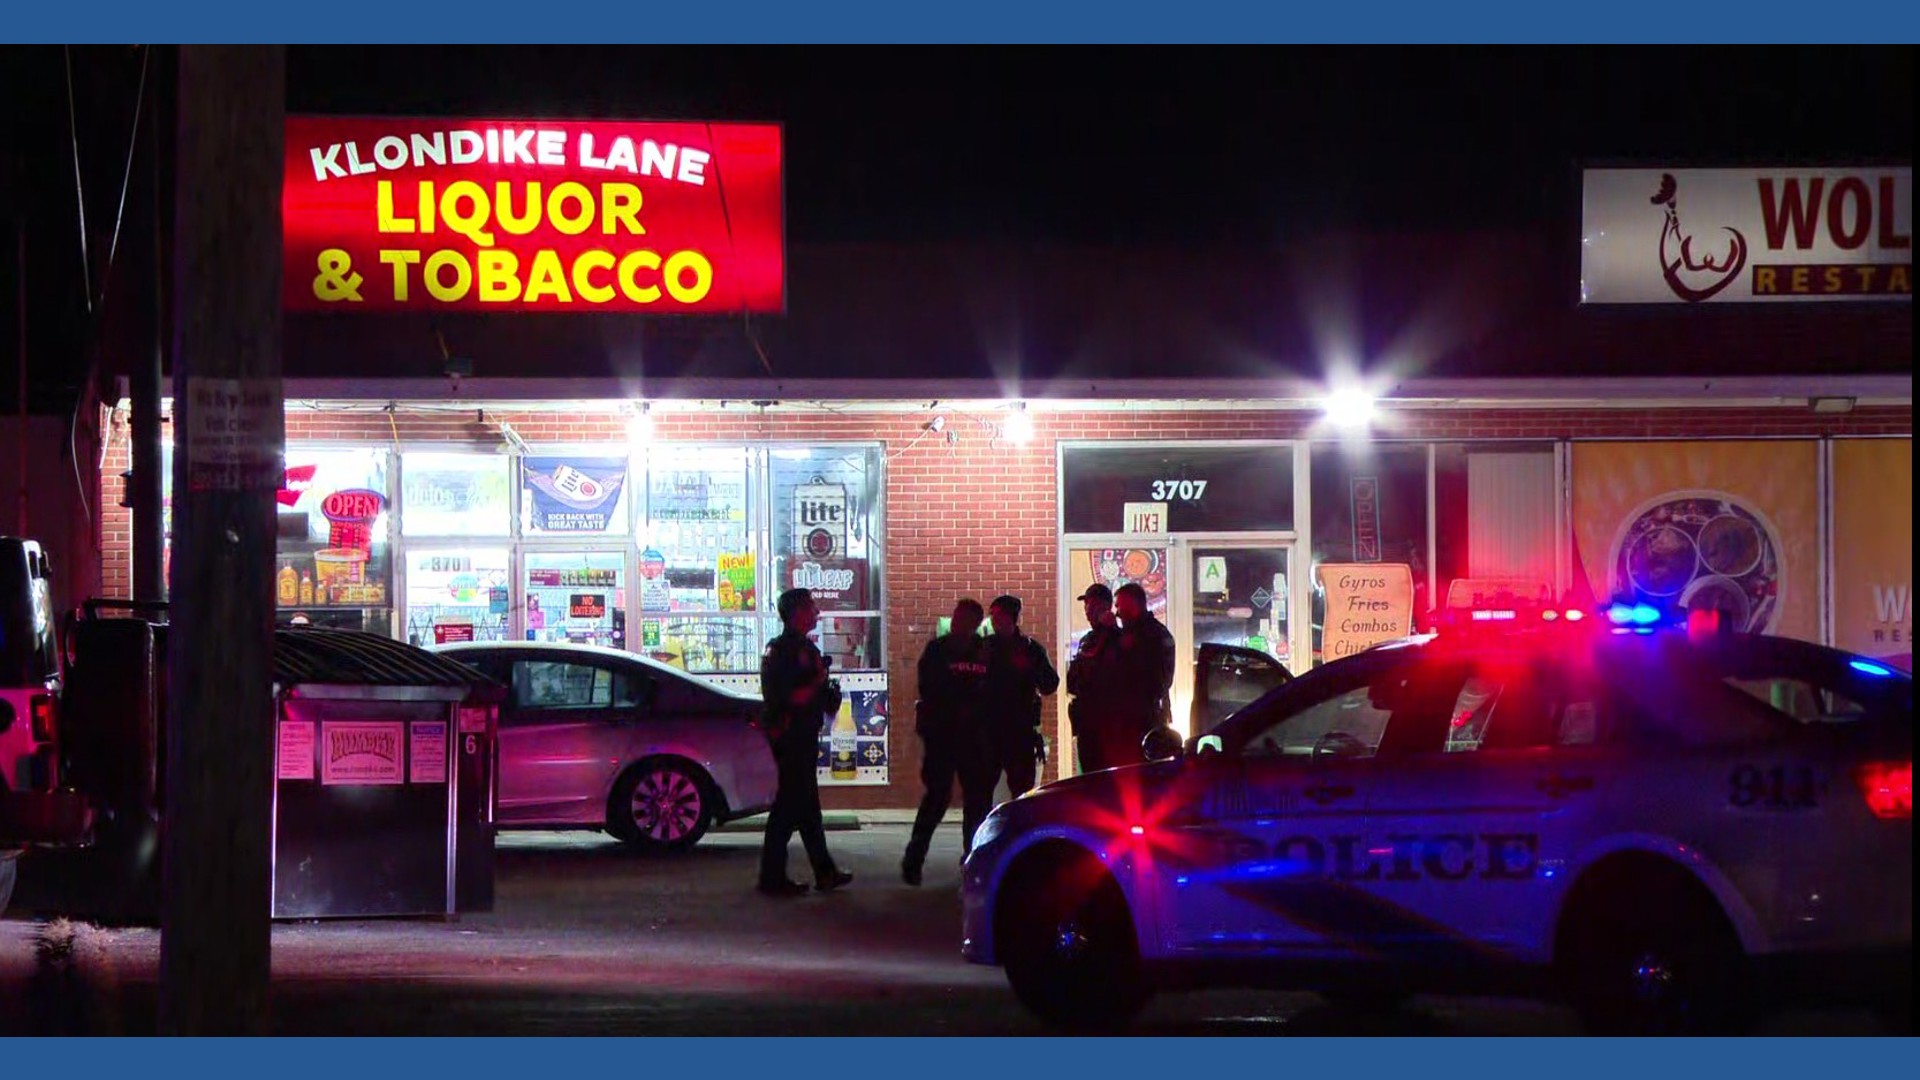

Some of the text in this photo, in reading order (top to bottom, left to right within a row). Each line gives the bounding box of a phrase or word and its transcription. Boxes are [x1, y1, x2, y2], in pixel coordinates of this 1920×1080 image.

[309, 128, 711, 186] KLONDIKE LANE
[377, 180, 646, 247] LIQUOR
[1757, 176, 1911, 250] WOL
[312, 248, 714, 304] & TOBACCO
[1756, 266, 1911, 293] RESTA
[1152, 480, 1208, 501] 3707
[326, 493, 378, 517] OPEN
[801, 500, 841, 527] Lite
[547, 513, 604, 521] KICK BACK WITH
[547, 521, 604, 530] GREAT TASTE
[1131, 513, 1159, 533] EXIT
[1354, 480, 1377, 560] OPEN
[1205, 562, 1220, 579] A
[1339, 574, 1386, 592] Gyros
[571, 605, 605, 616] LOITERING
[582, 596, 594, 606] NO
[1347, 595, 1390, 612] Fries
[1871, 584, 1912, 623] W
[1341, 619, 1398, 633] Combos
[465, 734, 477, 755] 6
[1214, 831, 1541, 883] POLICE
